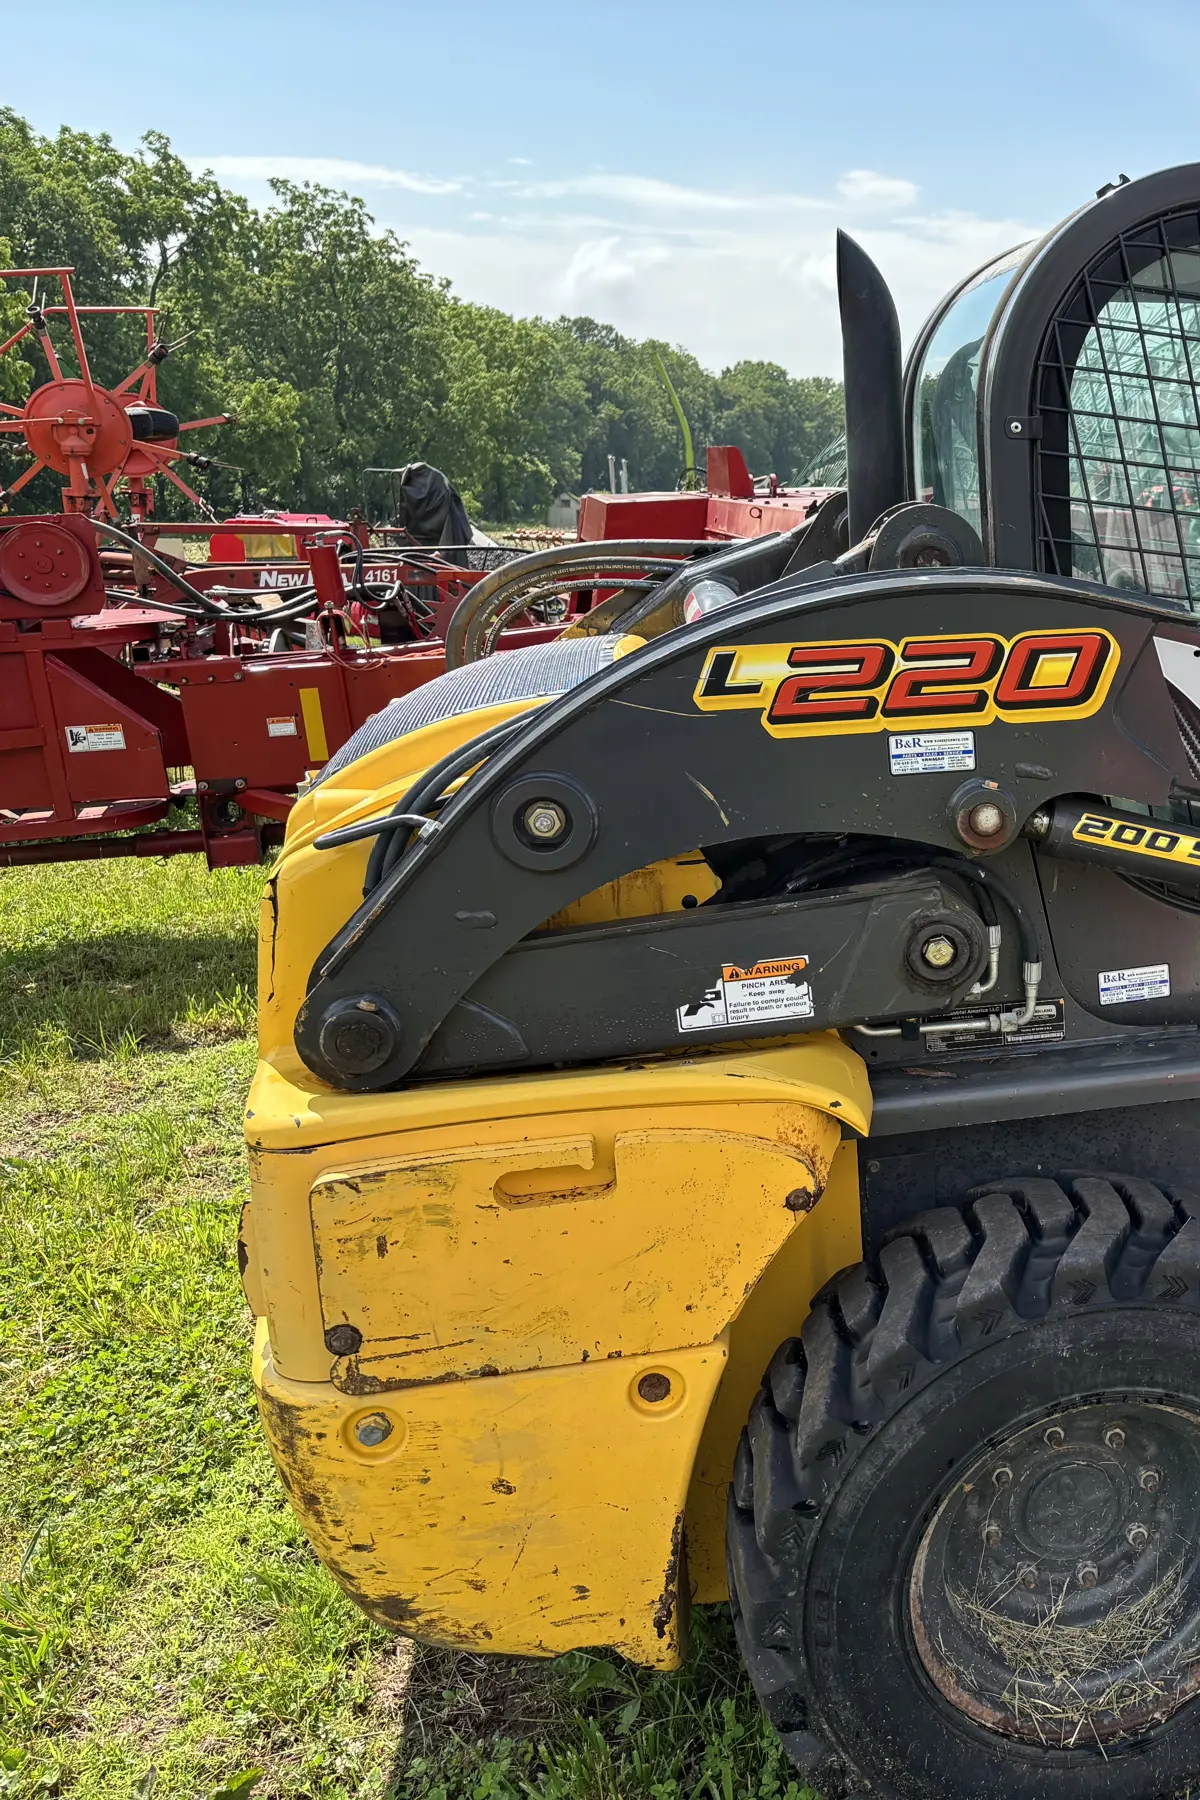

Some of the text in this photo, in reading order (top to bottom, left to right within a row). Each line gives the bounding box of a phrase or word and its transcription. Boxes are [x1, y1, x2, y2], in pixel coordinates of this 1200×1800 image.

[259, 570, 305, 587] NEW
[364, 568, 398, 583] 4161
[698, 631, 1112, 726] L220
[894, 737, 922, 750] B&R
[1075, 816, 1182, 854] 200
[744, 963, 800, 976] WARNING
[741, 979, 787, 990] PINCH ARE
[1103, 972, 1126, 984] B&R
[728, 1001, 752, 1009] Failure
[760, 996, 785, 1005] comply
[785, 994, 804, 1002] could
